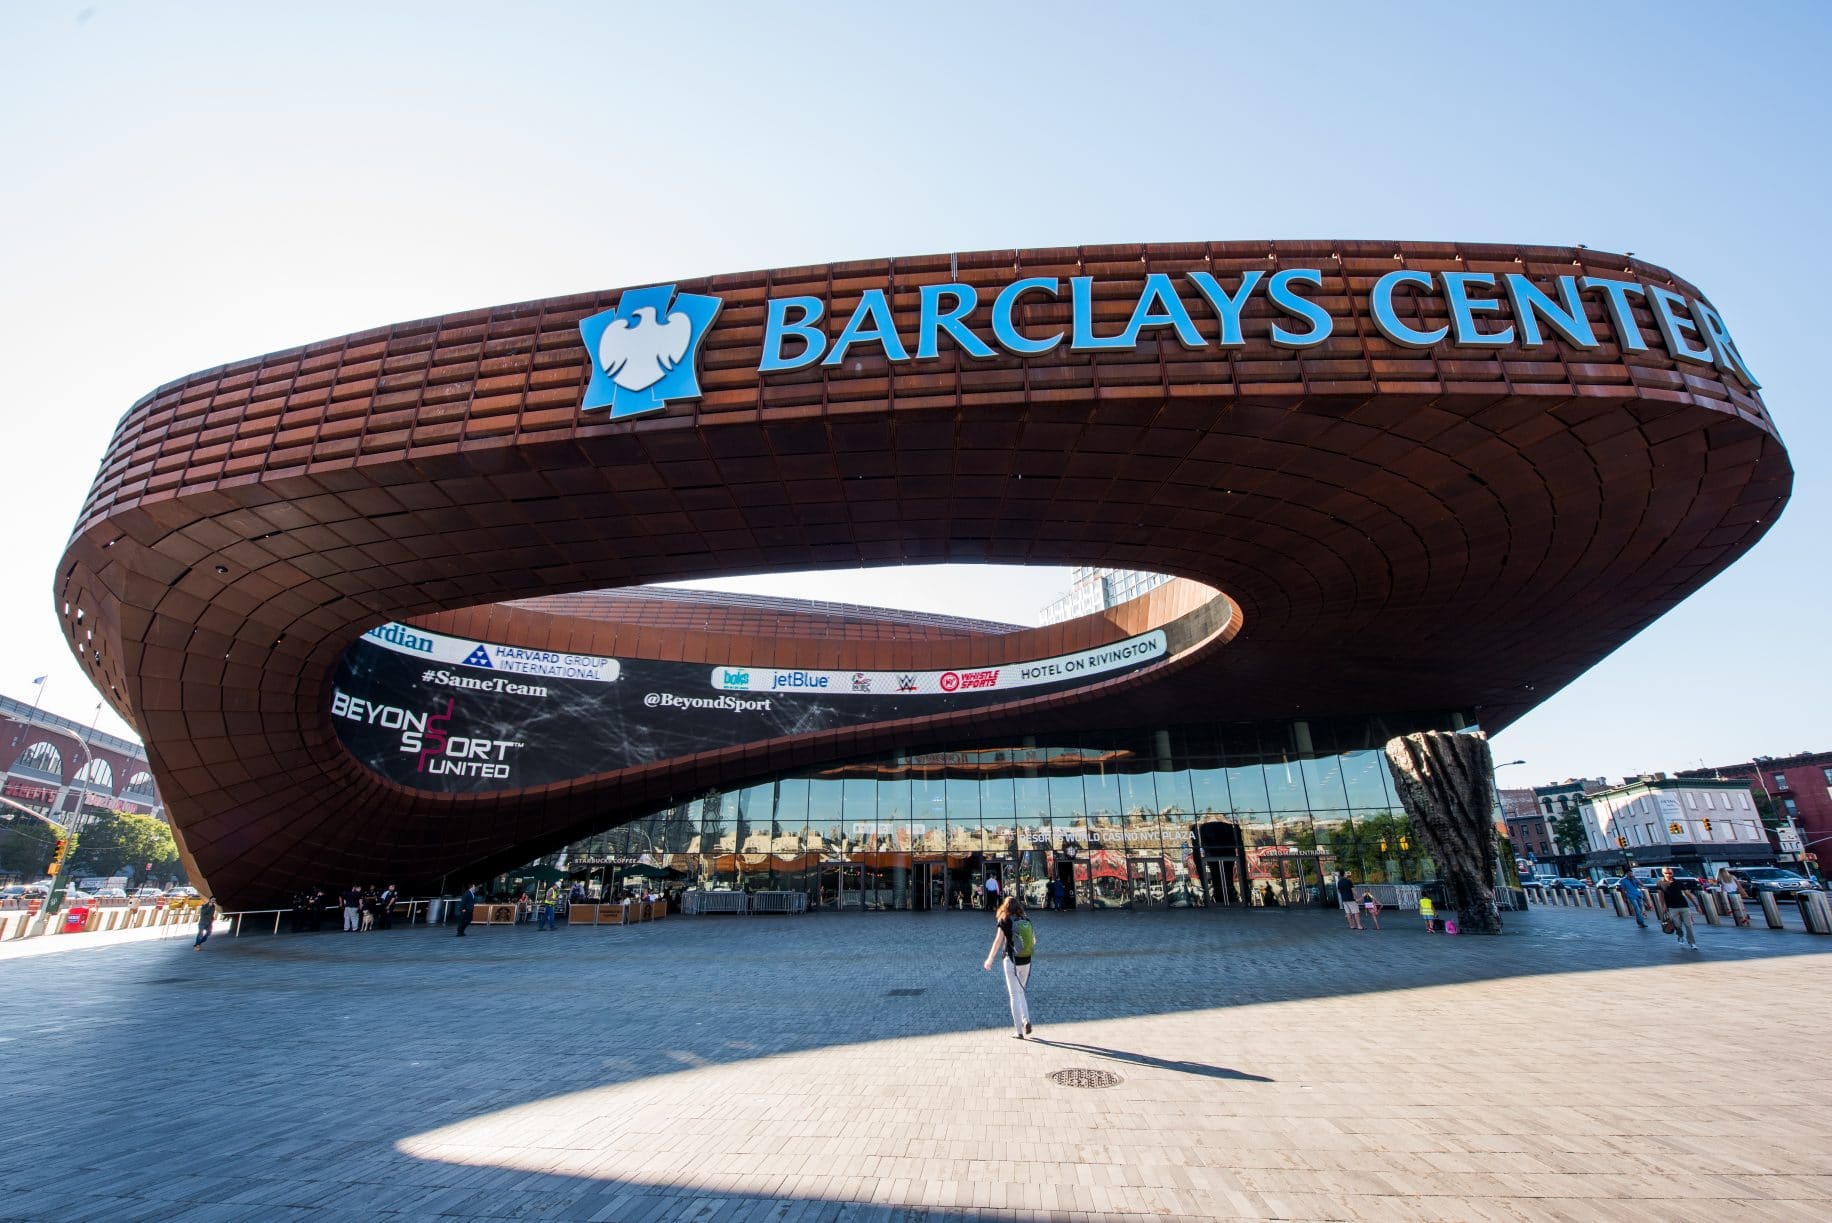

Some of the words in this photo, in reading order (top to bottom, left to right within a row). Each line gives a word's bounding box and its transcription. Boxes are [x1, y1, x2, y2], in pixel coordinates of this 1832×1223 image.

[757, 267, 1334, 373] BARCLAYS
[1369, 268, 1763, 391] CENTER
[496, 646, 560, 664] HARVARD
[564, 655, 609, 668] GROUP
[1021, 664, 1062, 680] HOTEL
[1065, 659, 1085, 673] ON
[1089, 638, 1158, 668] RIVINGTON
[500, 660, 601, 680] INTERNATIONAL
[772, 671, 829, 690] jetBlue
[961, 670, 1000, 681] WHISTLE
[421, 669, 548, 698] #SameTeam
[960, 679, 997, 689] SPORTS
[643, 692, 772, 713] @BeyondSport
[428, 758, 510, 779] UNITED
[1065, 831, 1100, 842] WORLD
[1103, 832, 1138, 841] CASINO
[1162, 831, 1197, 840] PLAZA
